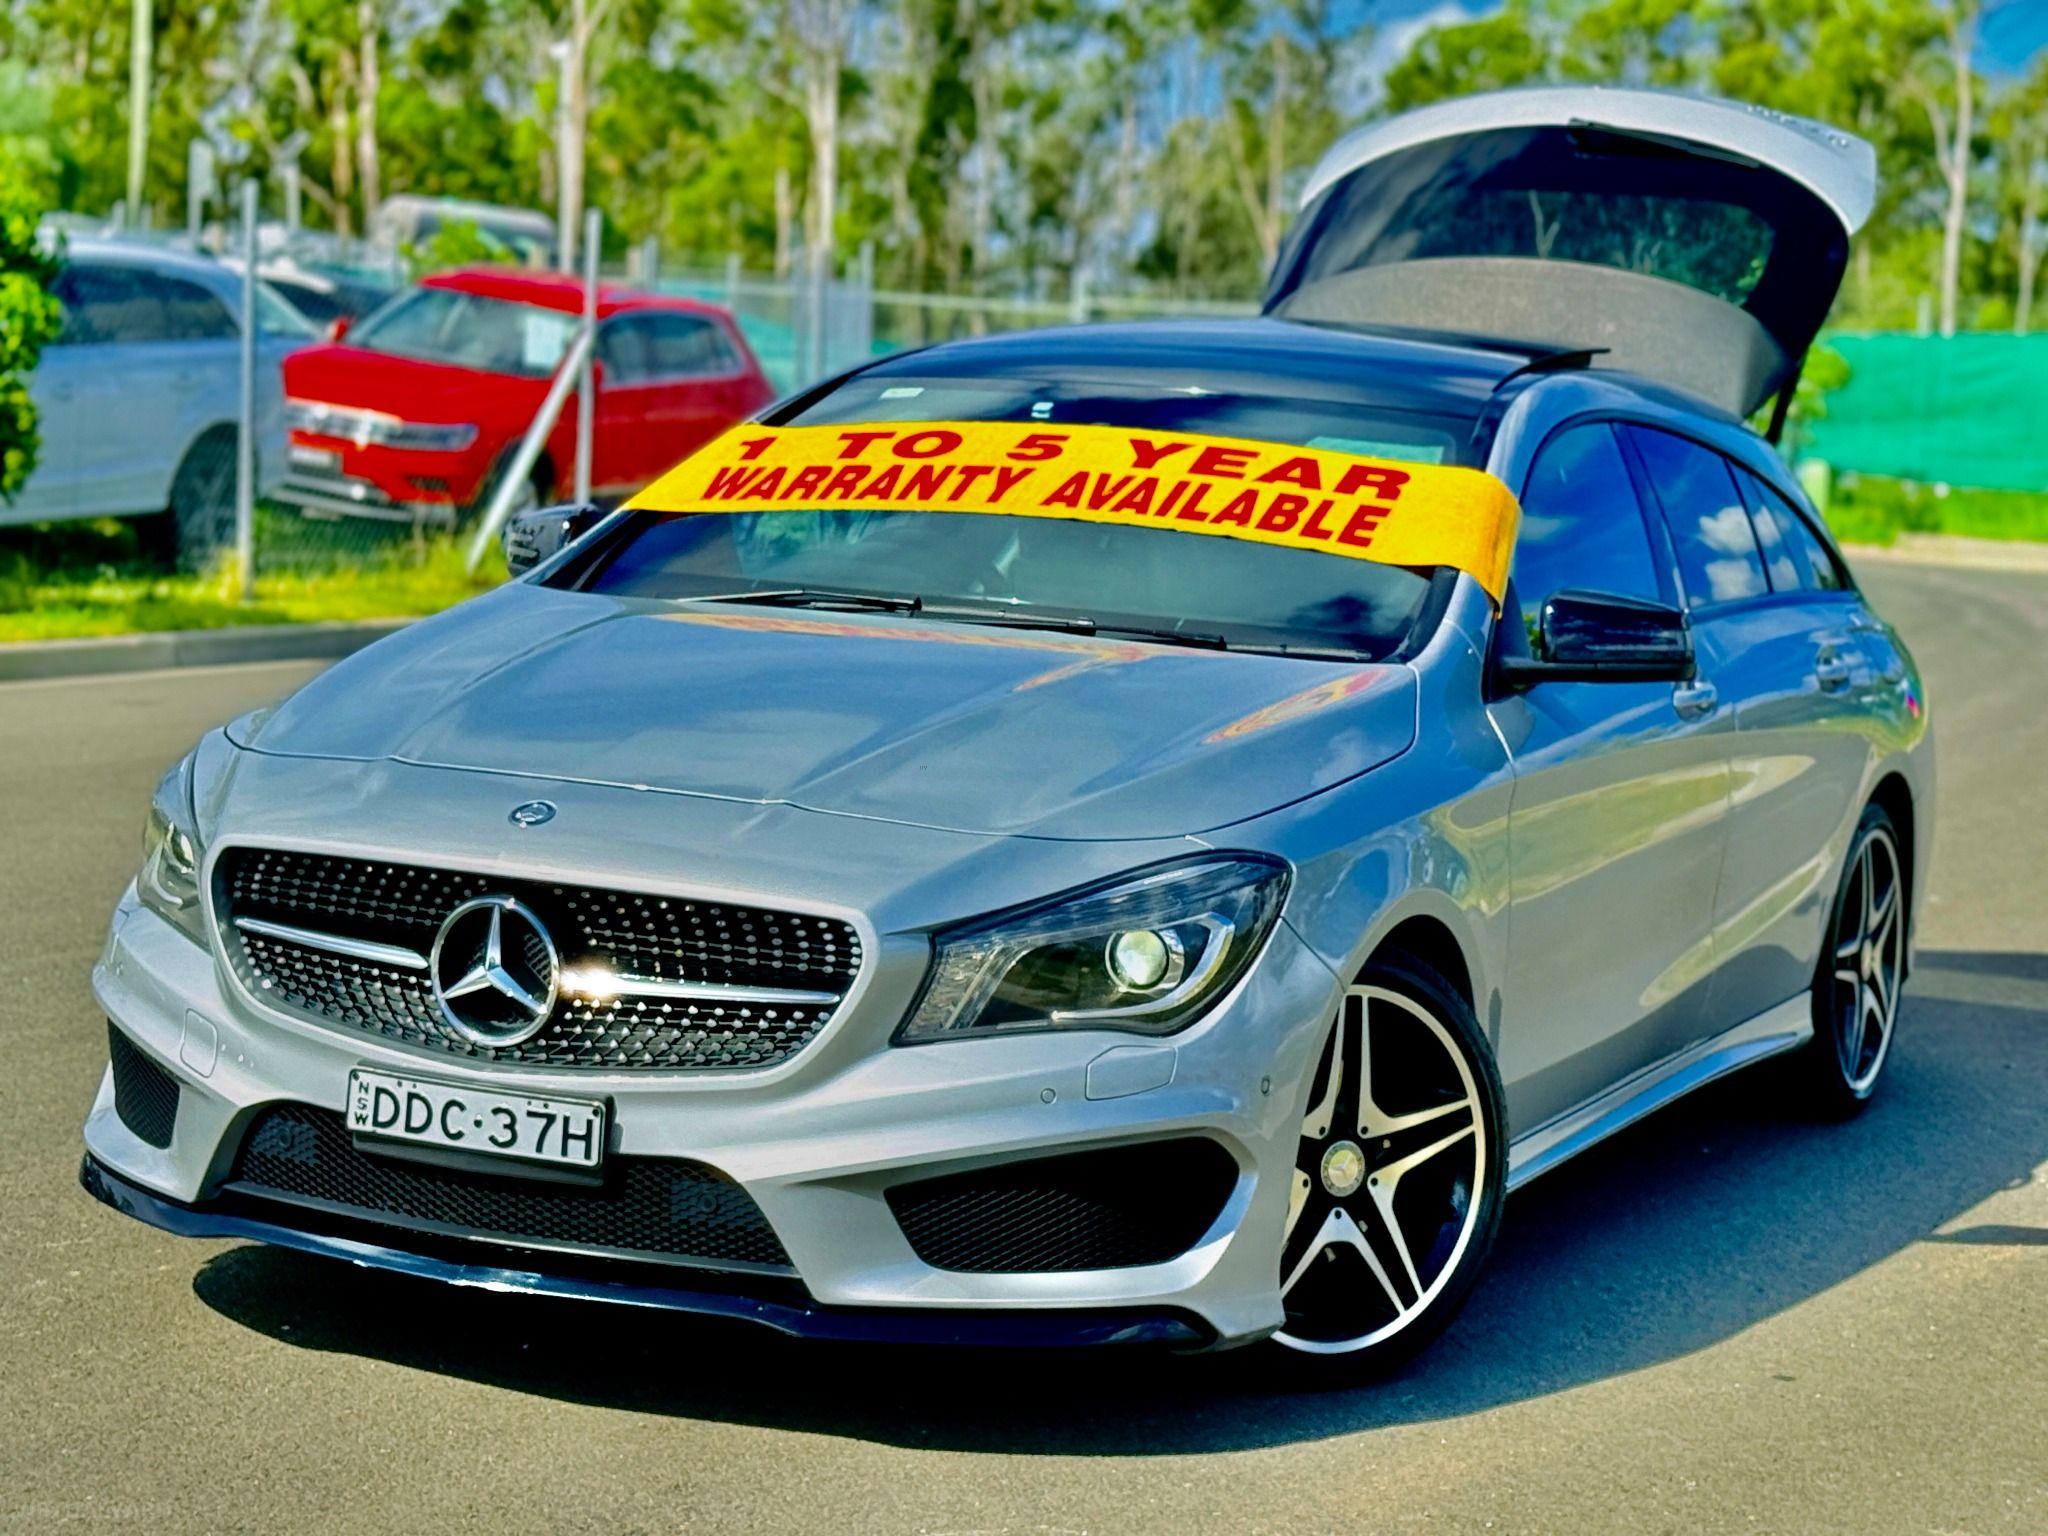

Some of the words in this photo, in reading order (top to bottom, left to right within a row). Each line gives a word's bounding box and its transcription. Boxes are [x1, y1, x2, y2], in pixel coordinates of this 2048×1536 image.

[740, 436, 777, 461] 1
[838, 431, 963, 459] TO
[1006, 434, 1070, 461] 5
[1129, 439, 1411, 501] YEAR
[702, 464, 1036, 503] WARRANTY
[1040, 471, 1391, 548] AVAILABLE
[354, 1081, 369, 1126] NSW
